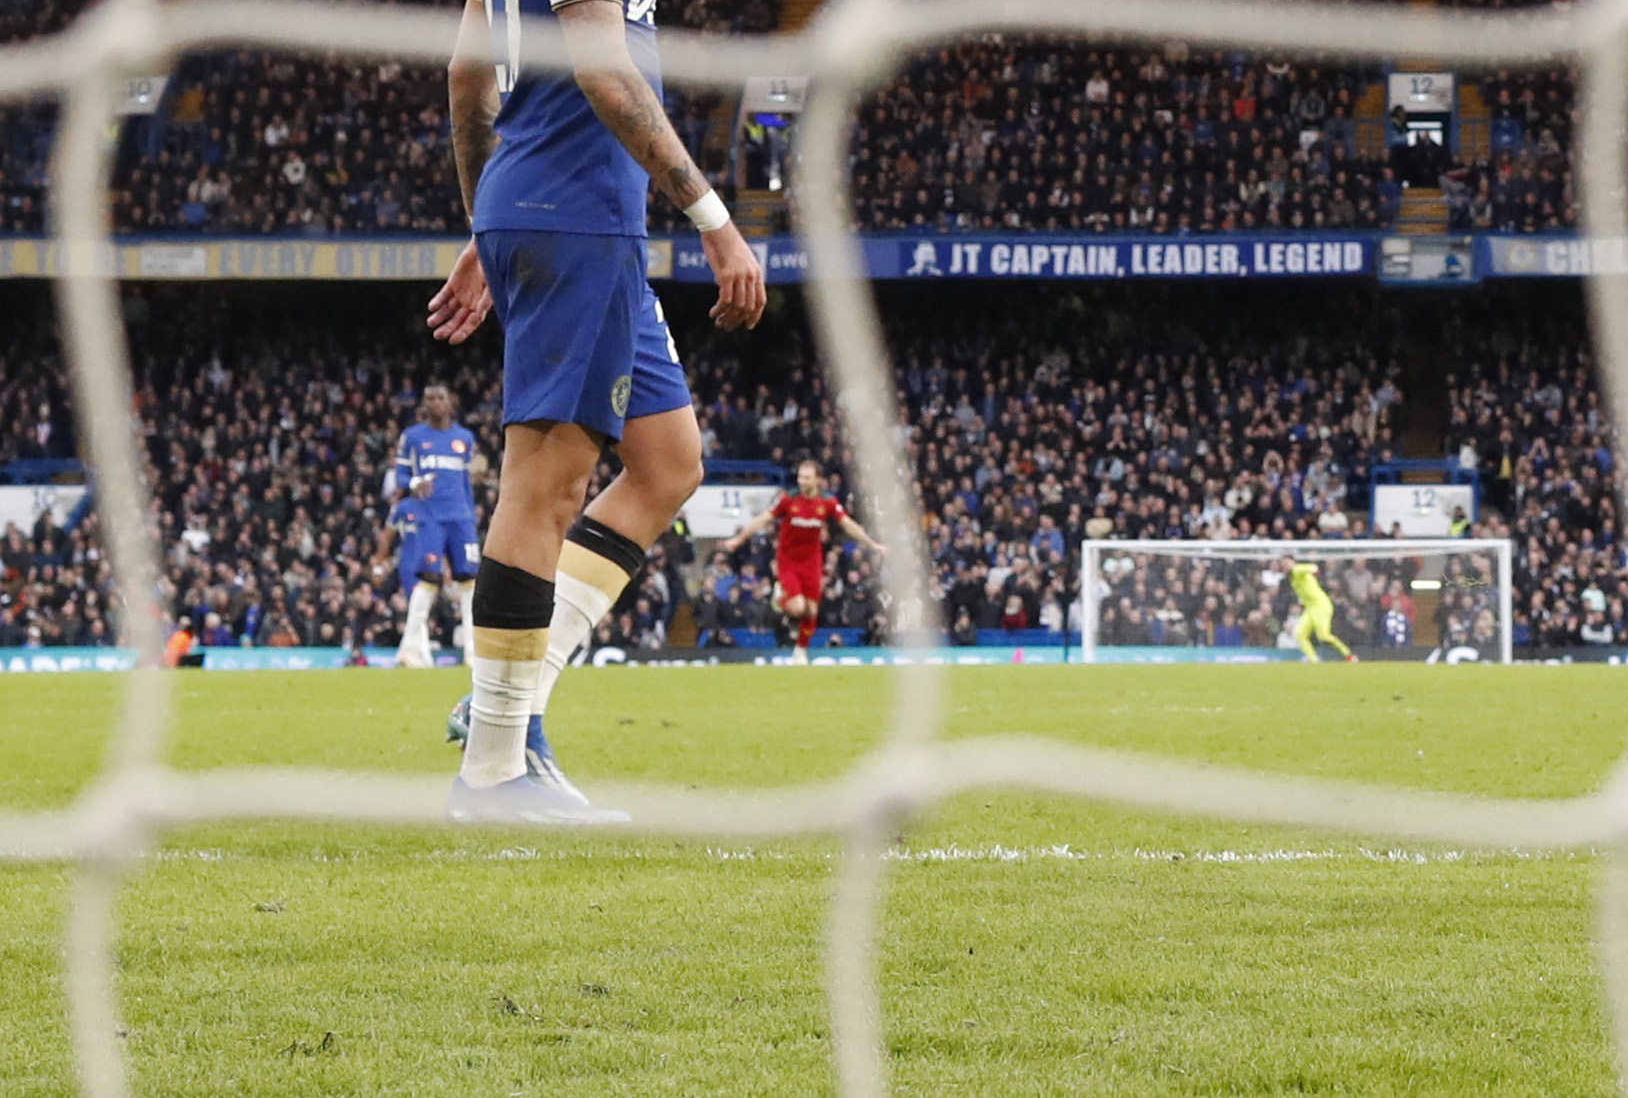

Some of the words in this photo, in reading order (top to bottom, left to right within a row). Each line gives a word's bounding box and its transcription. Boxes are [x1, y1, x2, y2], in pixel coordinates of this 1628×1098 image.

[1411, 76, 1434, 95] 12
[950, 242, 982, 275] JT
[990, 243, 1126, 278] CAPTAIN,
[1131, 243, 1249, 278] LEADER,
[1254, 241, 1364, 274] LEGEND
[1412, 486, 1436, 507] 12
